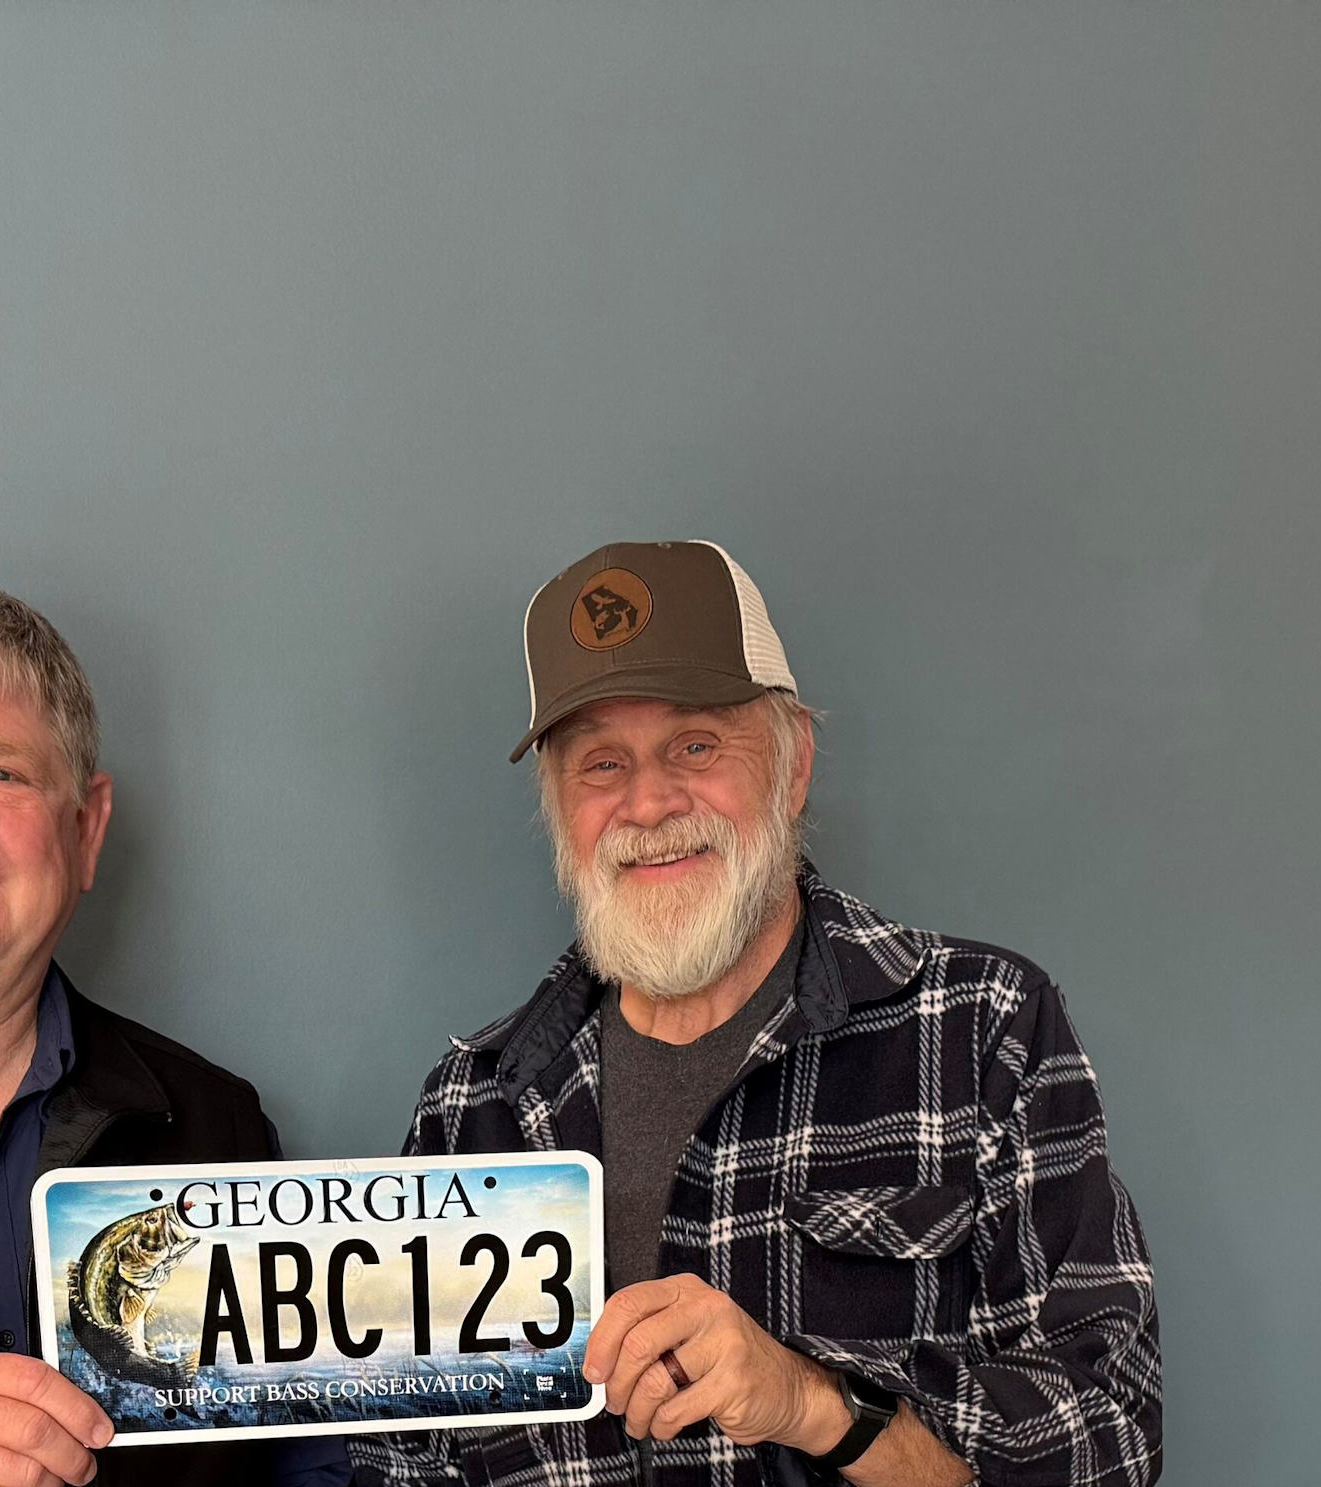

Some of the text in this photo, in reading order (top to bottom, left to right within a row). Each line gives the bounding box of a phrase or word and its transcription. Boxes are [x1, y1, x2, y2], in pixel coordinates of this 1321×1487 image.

[177, 1172, 481, 1230] GEORGIA
[198, 1230, 576, 1367] ABC123
[154, 1372, 506, 1408] SUPPORT BASS CONSERVATION
